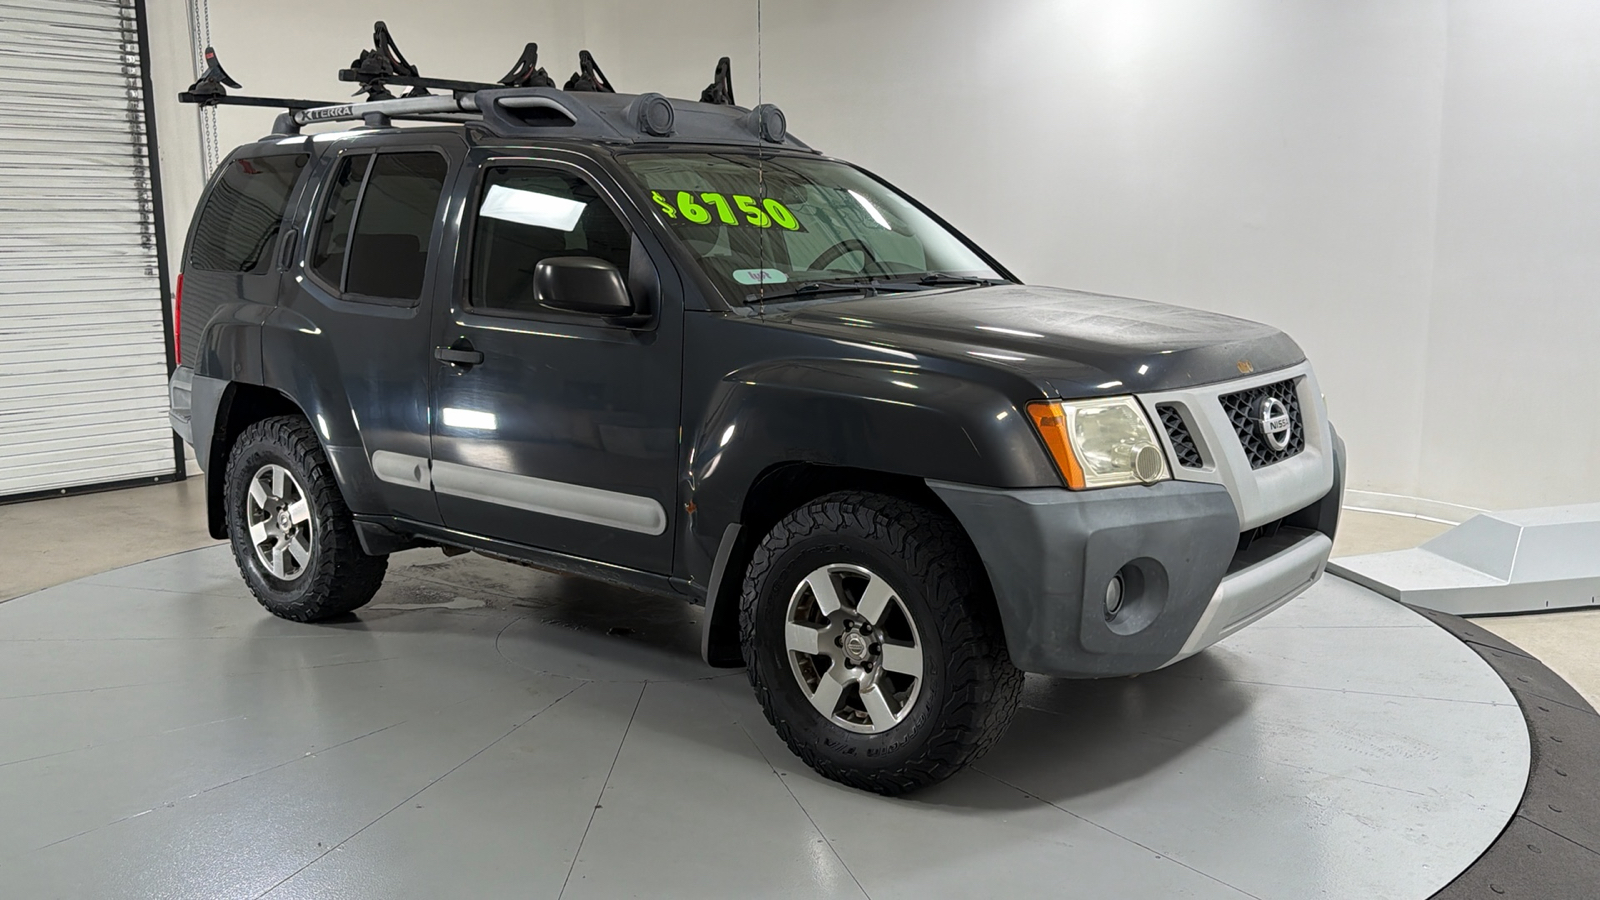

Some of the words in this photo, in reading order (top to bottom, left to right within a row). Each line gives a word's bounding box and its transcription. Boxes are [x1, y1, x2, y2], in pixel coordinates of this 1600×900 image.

[301, 106, 352, 121] XTERRA
[651, 190, 800, 231] $6750
[1270, 417, 1289, 431] NISS
